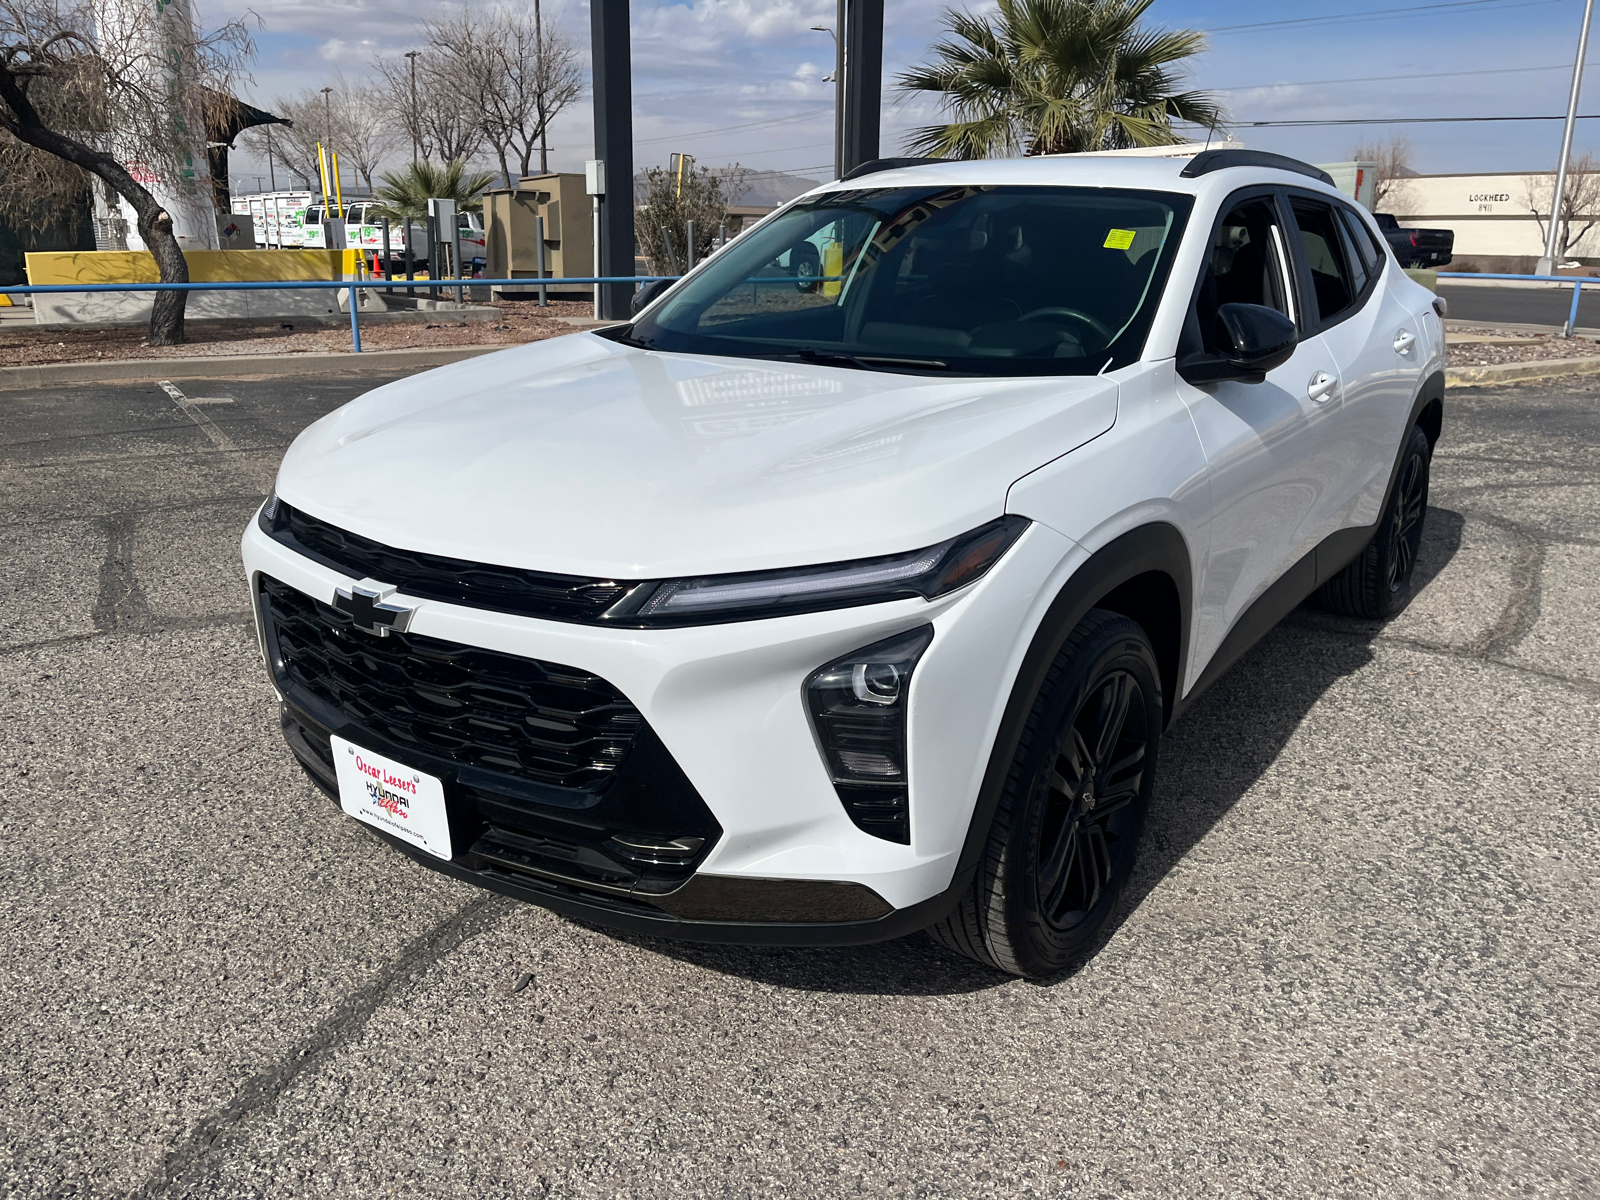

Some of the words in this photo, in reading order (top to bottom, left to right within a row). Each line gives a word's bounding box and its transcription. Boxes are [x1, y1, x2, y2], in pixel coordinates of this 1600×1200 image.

[1469, 194, 1510, 202] LOCKHEED
[1478, 203, 1493, 212] 8411
[356, 755, 381, 780] Oscar
[383, 769, 416, 795] Leeser's
[366, 781, 410, 809] HYUNDAI
